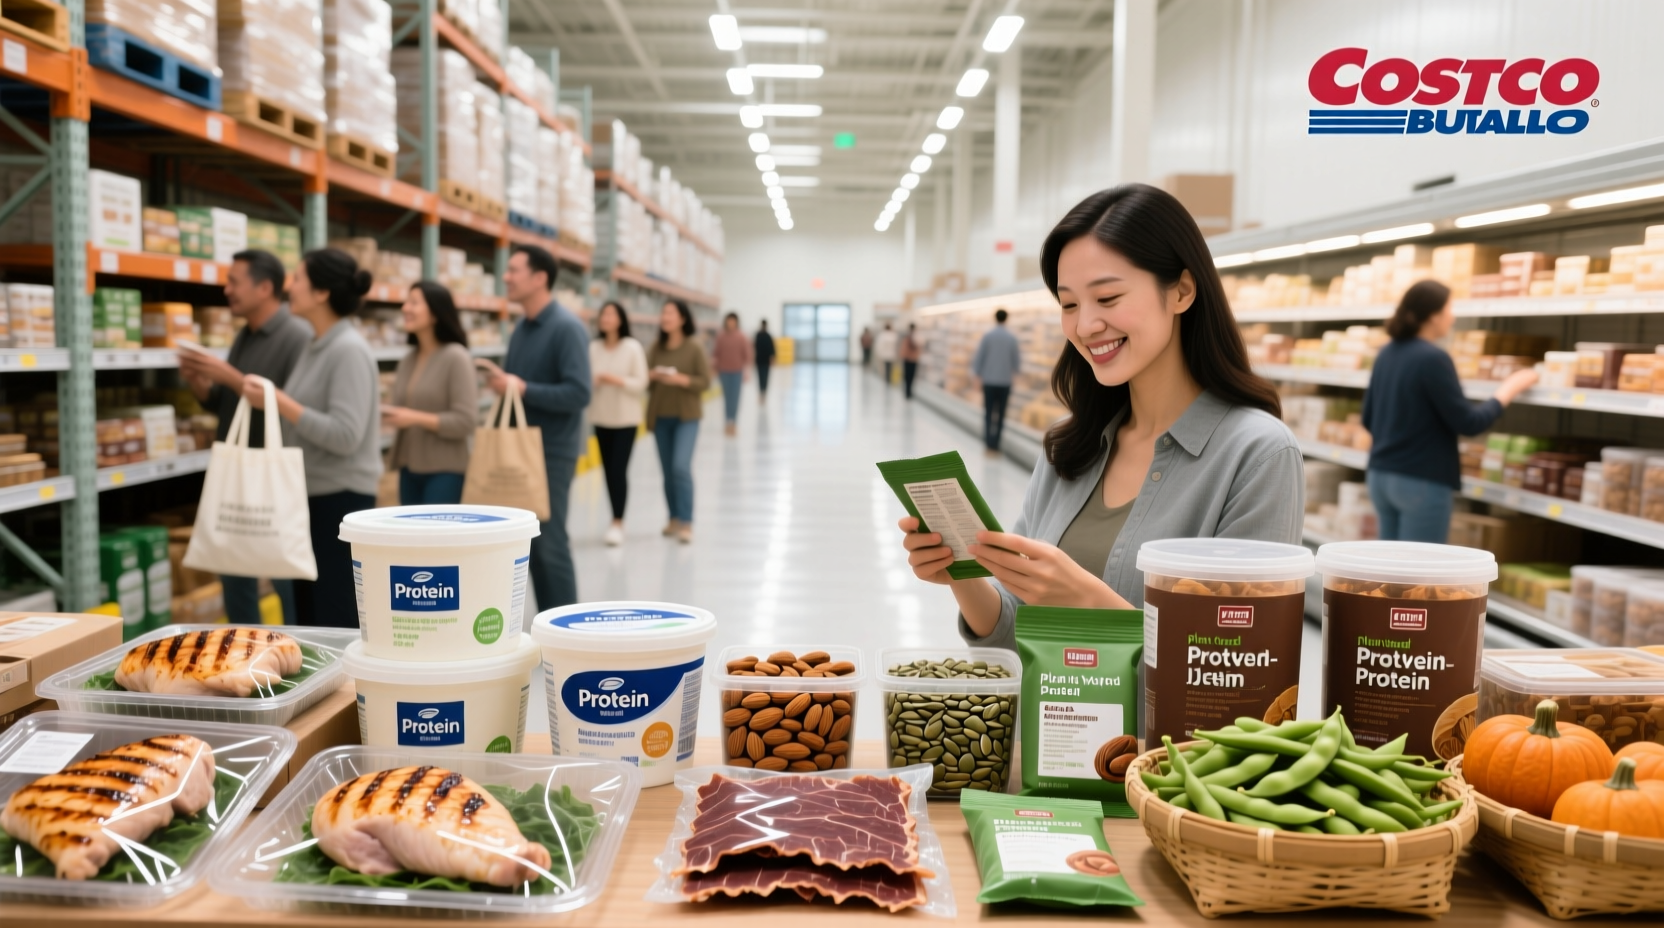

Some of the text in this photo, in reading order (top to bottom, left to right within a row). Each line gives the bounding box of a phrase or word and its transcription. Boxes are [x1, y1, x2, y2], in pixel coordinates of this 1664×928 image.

[394, 583, 454, 599] Protein
[1355, 667, 1430, 691] Protein
[578, 689, 649, 708] Protein
[402, 718, 460, 734] Protein
